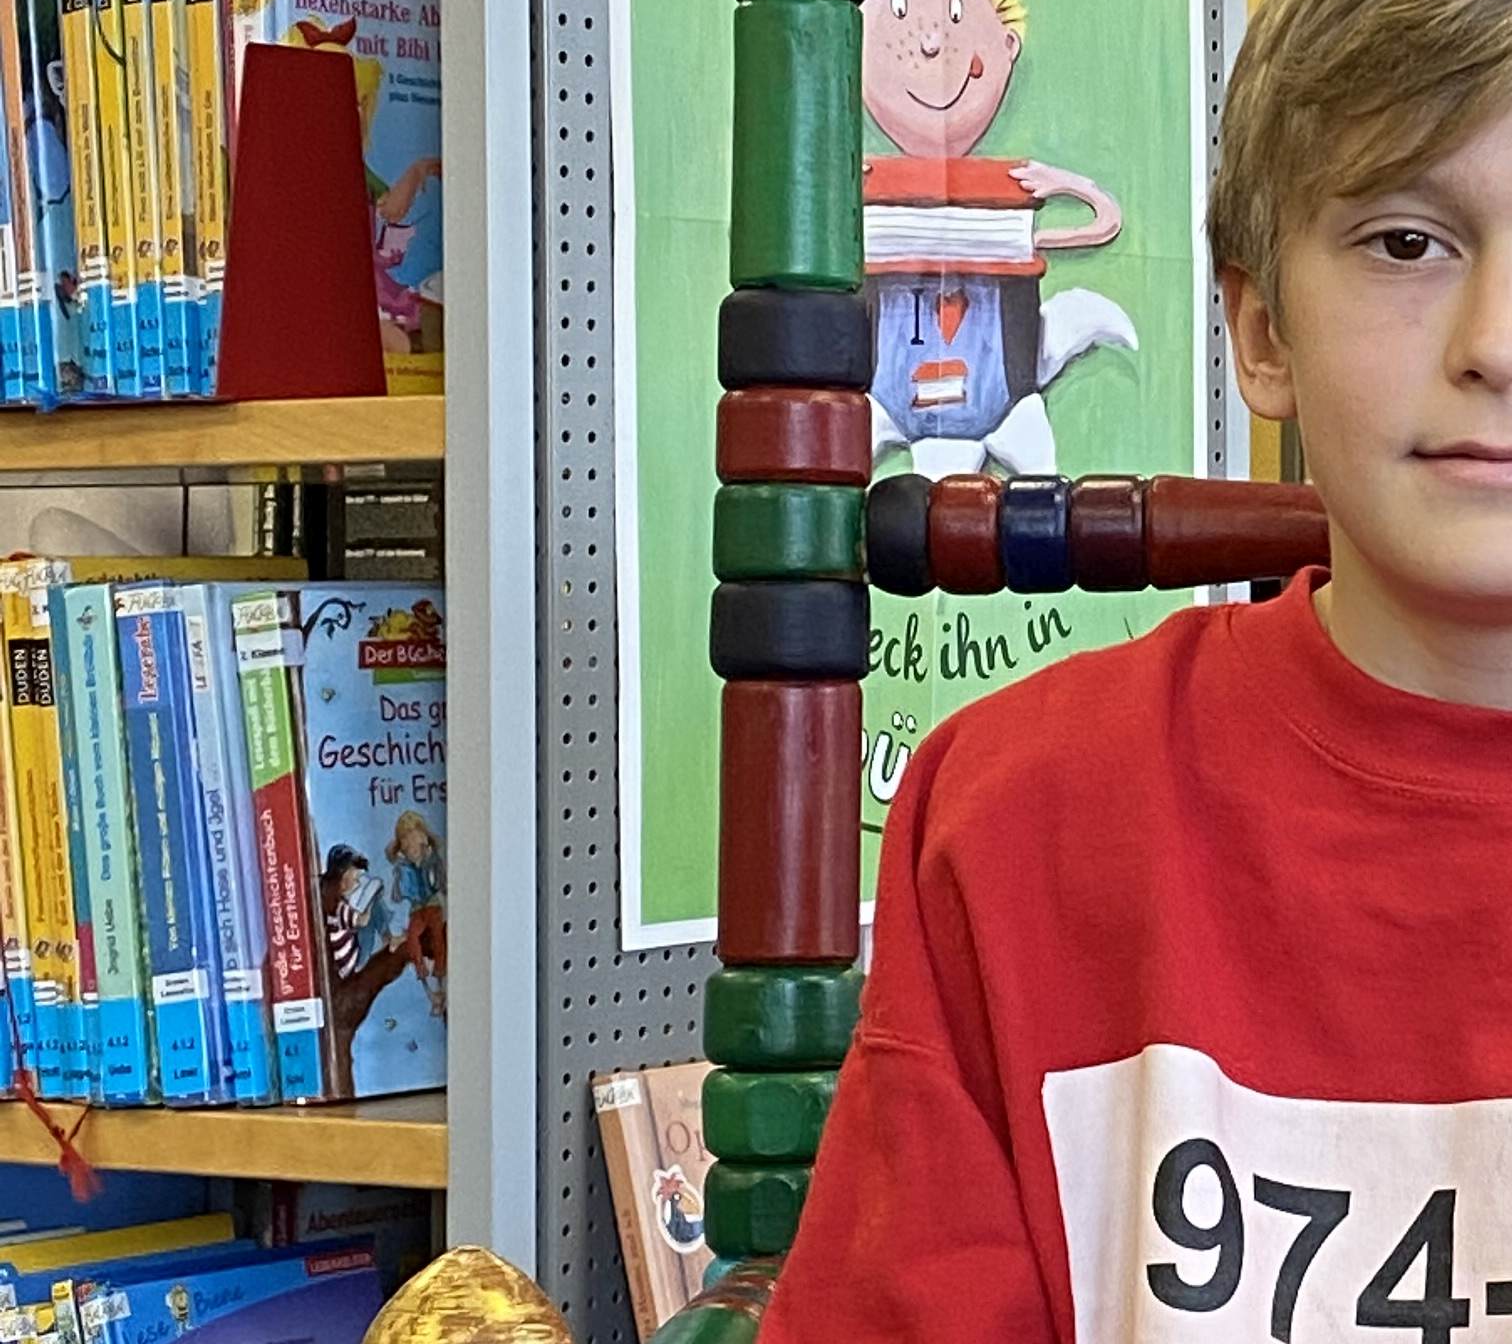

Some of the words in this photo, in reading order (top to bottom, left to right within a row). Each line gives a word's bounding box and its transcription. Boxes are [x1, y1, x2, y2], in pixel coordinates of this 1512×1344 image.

[420, 2, 440, 27] Ab
[356, 35, 388, 58] mit
[869, 612, 927, 683] eck
[940, 612, 1019, 680] ihn
[1024, 600, 1072, 653] in
[14, 649, 30, 703] DUDEN
[37, 649, 52, 704] DUDEN
[380, 695, 420, 722] Das
[319, 731, 445, 769] Geschich
[369, 777, 403, 807] für
[412, 774, 446, 803] Ers
